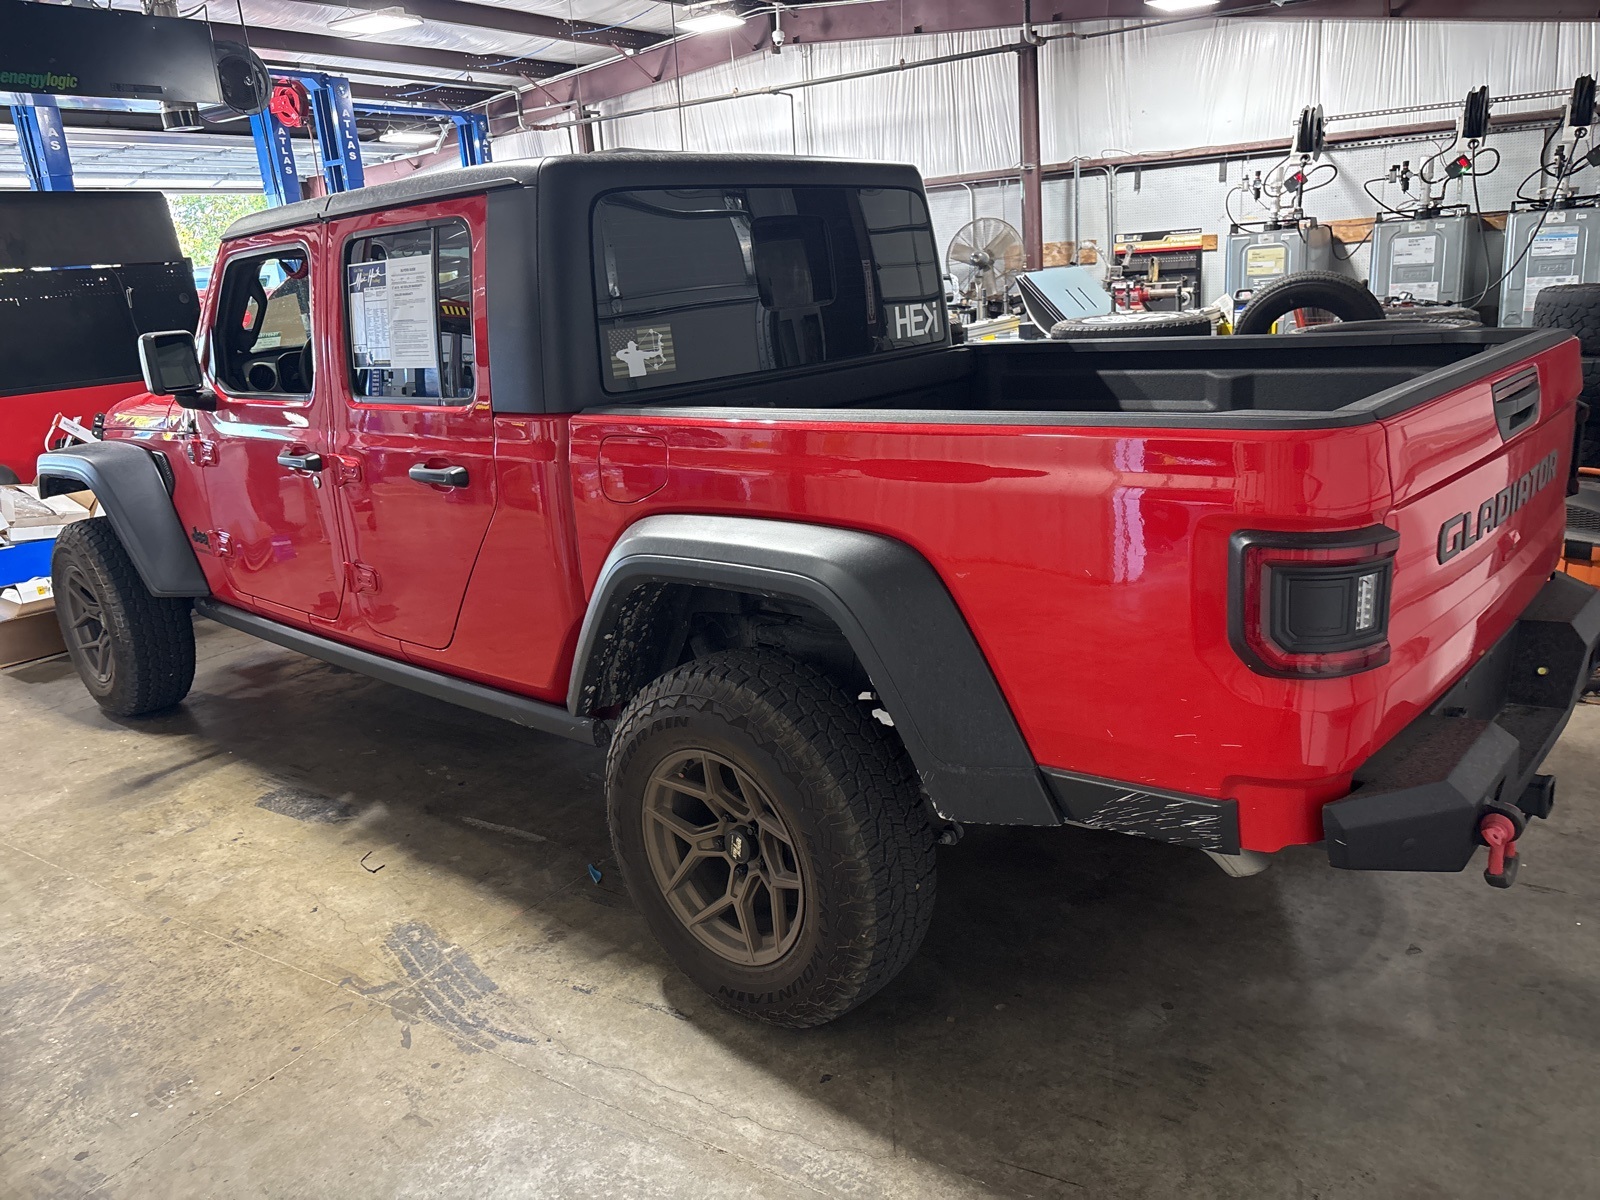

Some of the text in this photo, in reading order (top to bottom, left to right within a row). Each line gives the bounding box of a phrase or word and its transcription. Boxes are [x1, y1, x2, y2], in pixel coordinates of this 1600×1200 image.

[0, 71, 78, 90] energylogic
[278, 127, 293, 175] ATLAS
[342, 109, 357, 160] ATLAS
[1436, 448, 1558, 566] GLADIATOR
[717, 943, 824, 1004] MOUNTAIN
